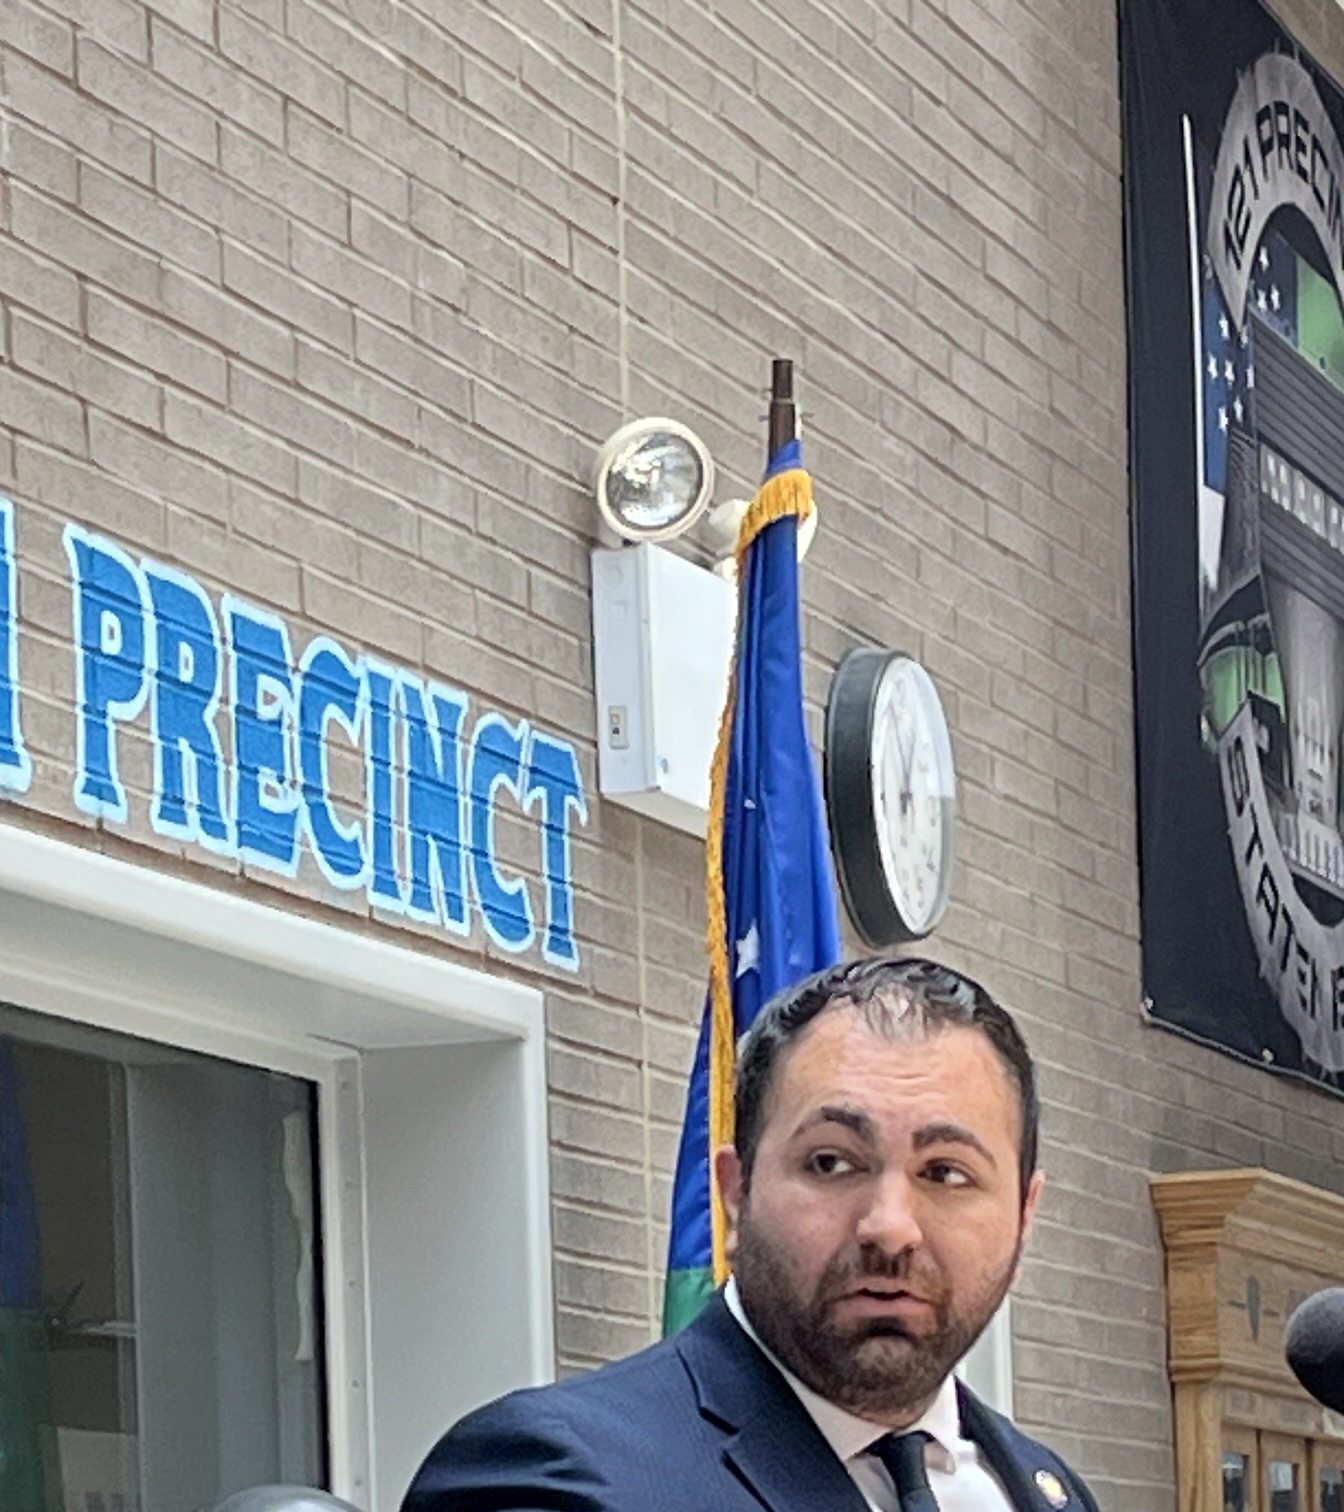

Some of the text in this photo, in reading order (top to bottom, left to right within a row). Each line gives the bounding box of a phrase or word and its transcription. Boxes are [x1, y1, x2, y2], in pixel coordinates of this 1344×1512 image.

[1223, 133, 1259, 272] 121
[63, 521, 590, 972] PRECINCT
[1227, 735, 1319, 1022] STATEN
